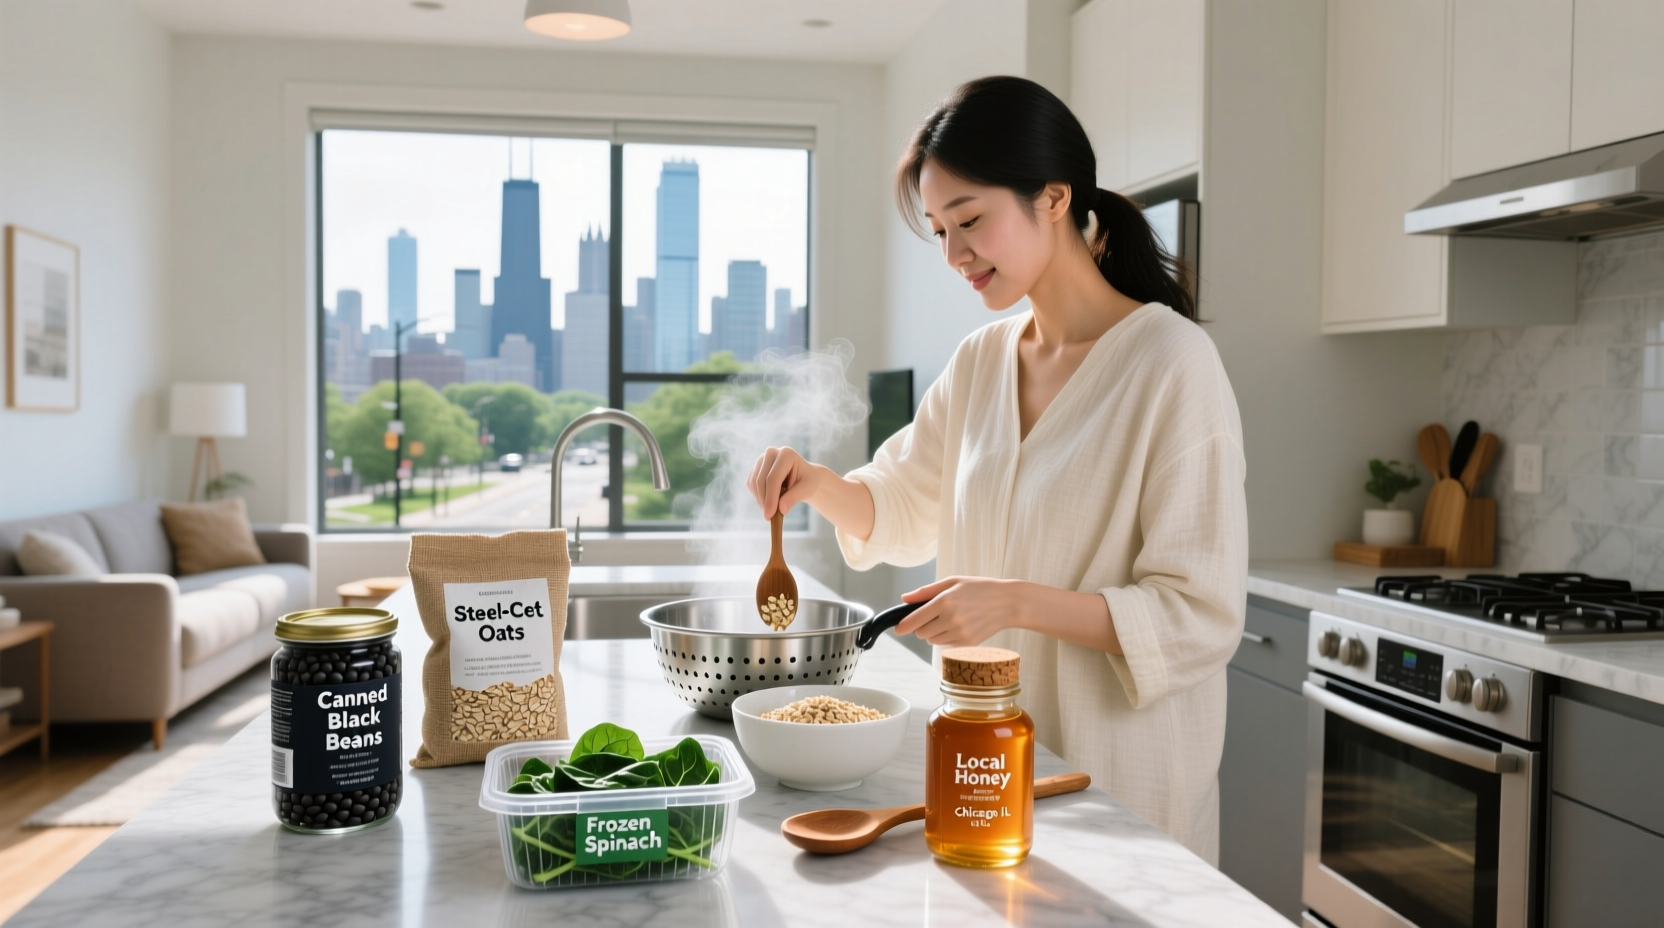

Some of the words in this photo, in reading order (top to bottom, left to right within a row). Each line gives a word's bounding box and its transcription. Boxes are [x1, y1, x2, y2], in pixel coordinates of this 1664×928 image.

[454, 601, 544, 622] Steel-Cet
[479, 625, 525, 642] Oats
[317, 683, 388, 709] Canned
[328, 706, 381, 730] Black
[326, 731, 383, 751] Beans
[956, 753, 1005, 769] Local
[955, 769, 1011, 790] Honey
[587, 817, 651, 833] Frozen
[585, 830, 661, 857] Spinach
